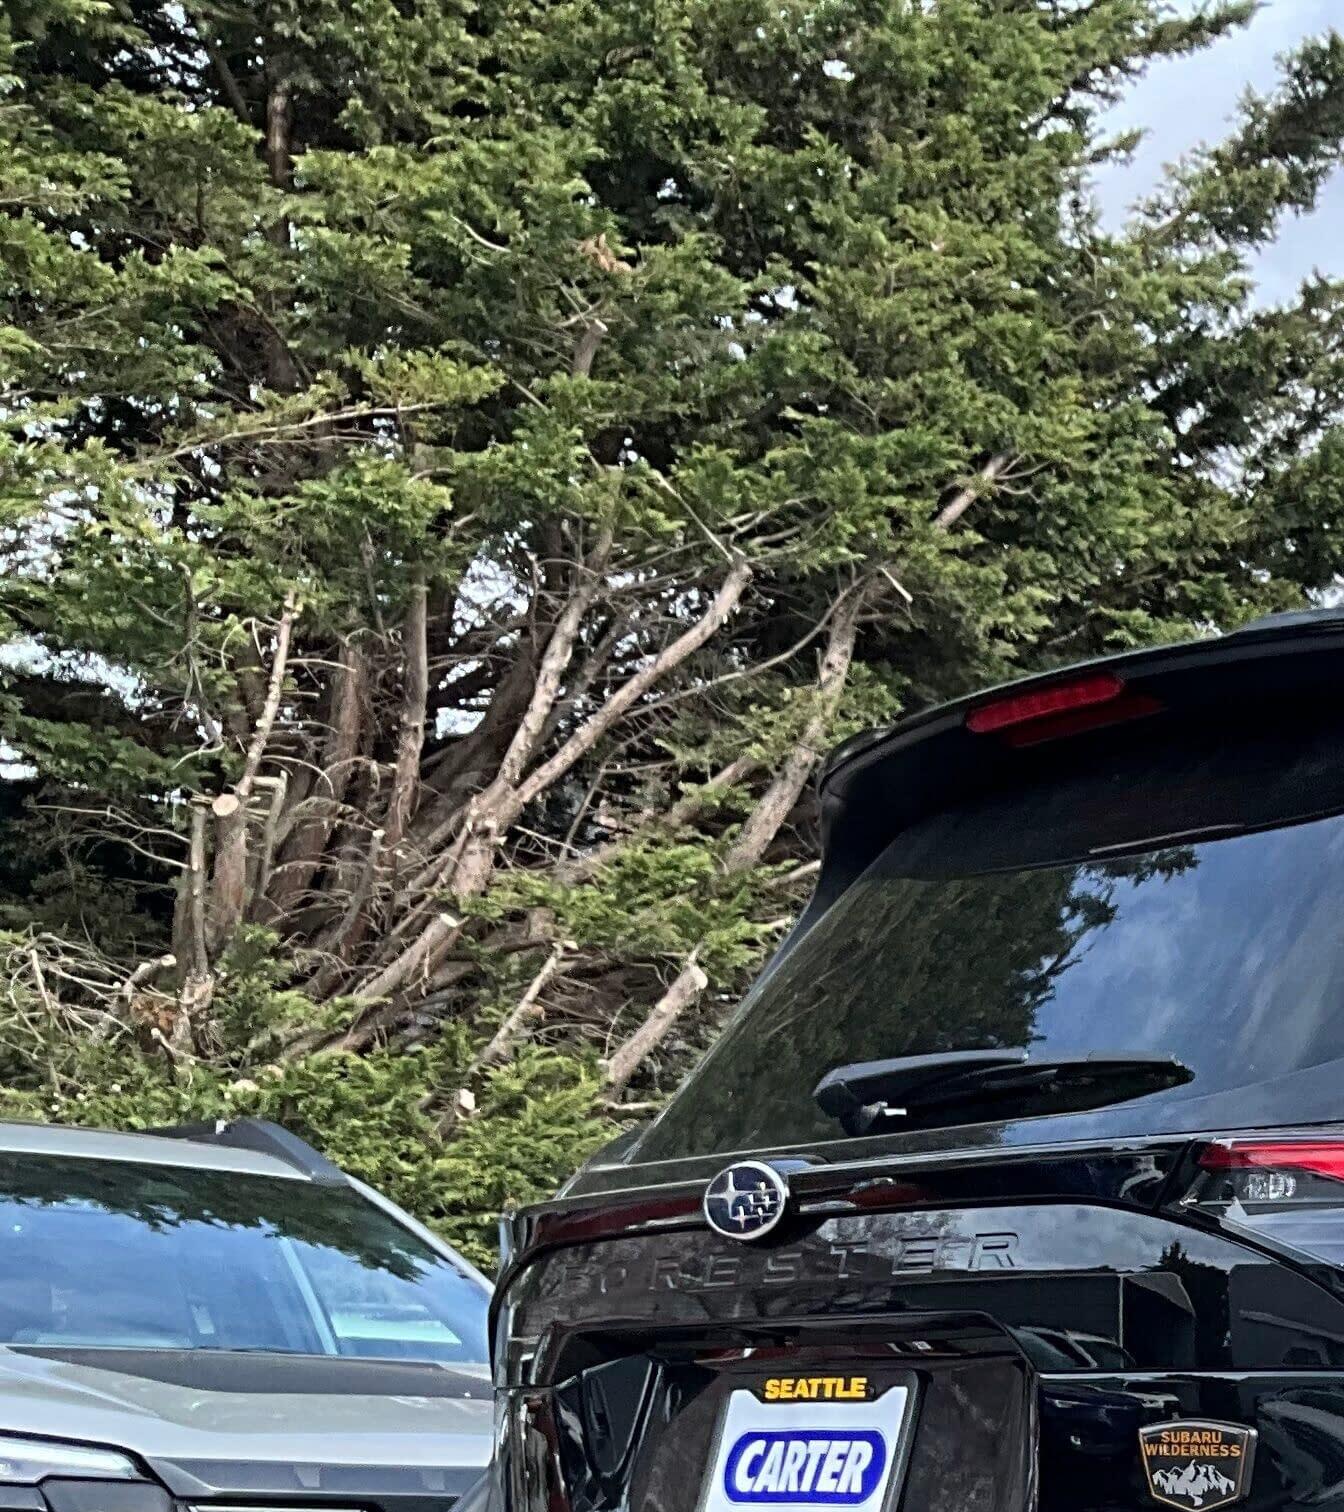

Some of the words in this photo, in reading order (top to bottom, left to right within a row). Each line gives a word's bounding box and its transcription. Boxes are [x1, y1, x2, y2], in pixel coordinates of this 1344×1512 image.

[764, 1377, 868, 1400] SEATTLE
[1160, 1431, 1222, 1444] SUBARU
[1144, 1443, 1241, 1457] WILDERNESS
[735, 1439, 874, 1494] CARTER
